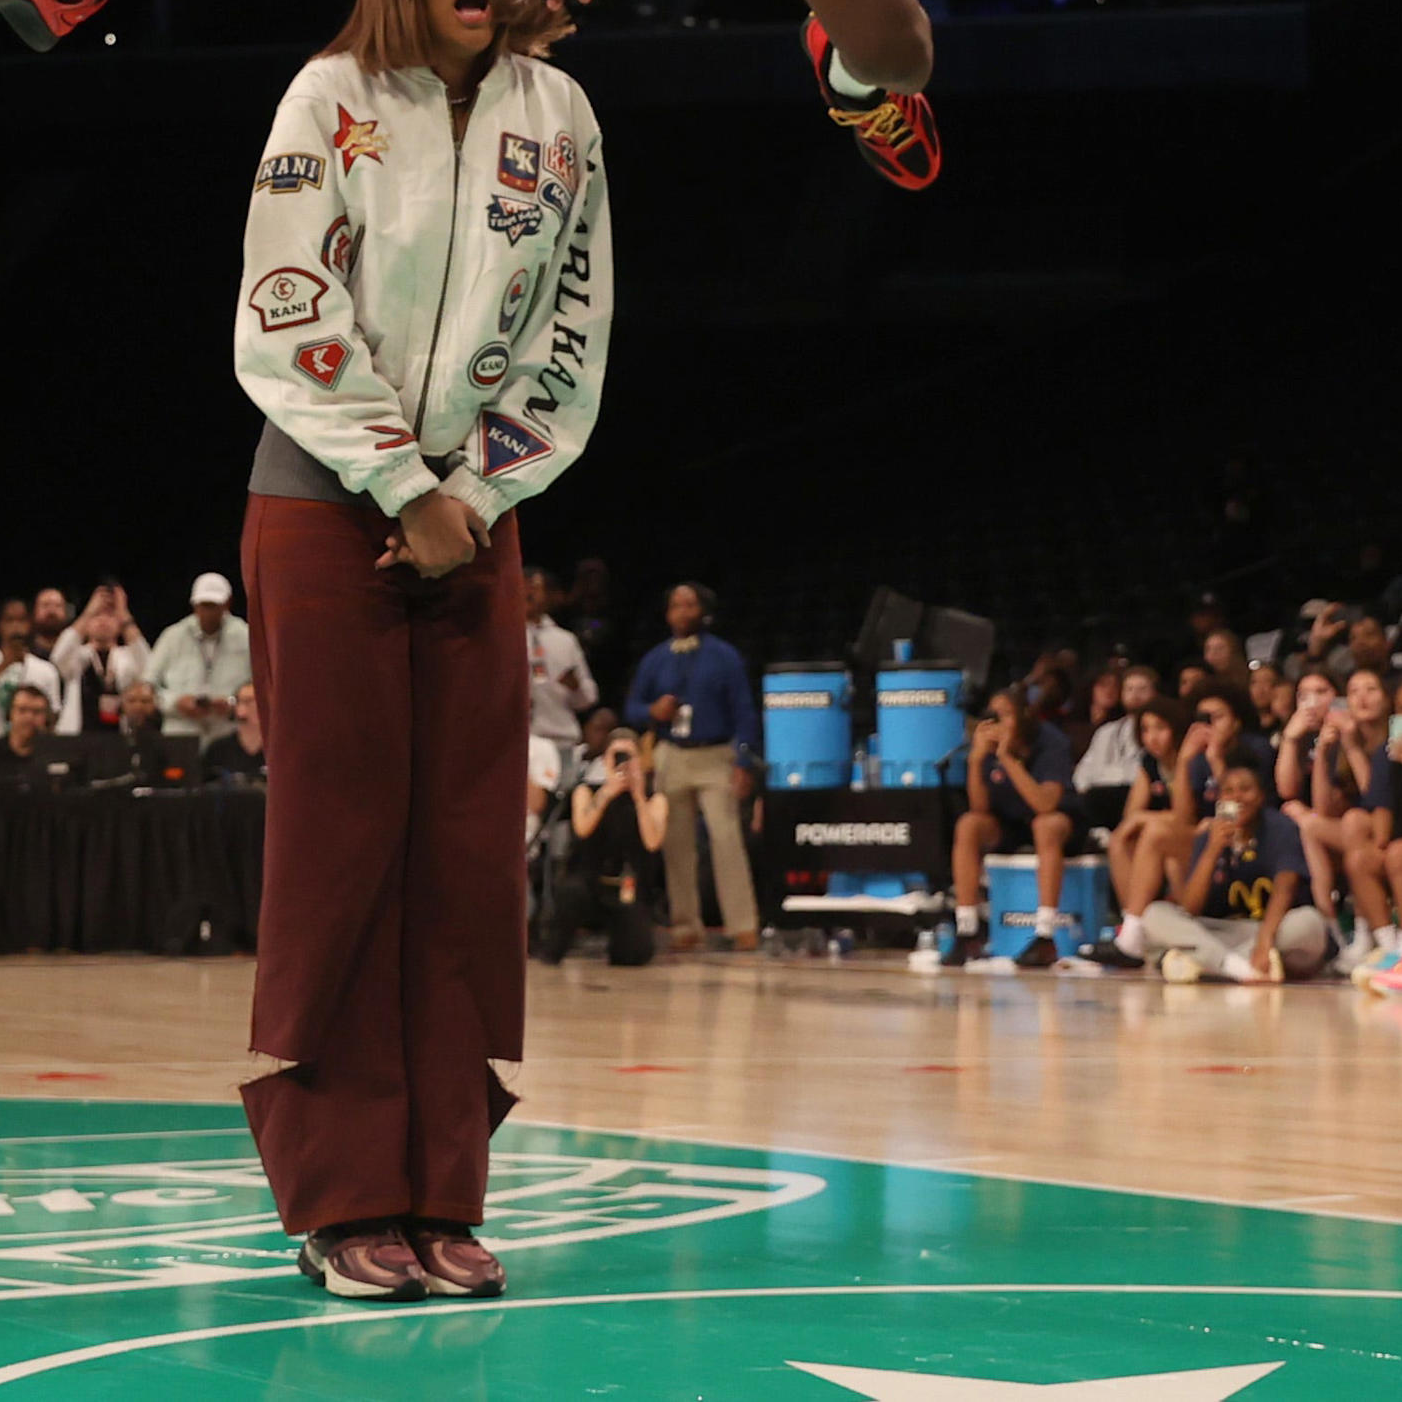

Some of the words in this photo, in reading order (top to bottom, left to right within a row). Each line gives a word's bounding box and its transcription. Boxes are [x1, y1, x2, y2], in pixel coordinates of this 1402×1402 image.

[260, 155, 319, 182] KANI
[505, 138, 536, 175] KK
[270, 302, 308, 319] KANI
[488, 426, 530, 458] KANI
[794, 820, 912, 847] POWERADE
